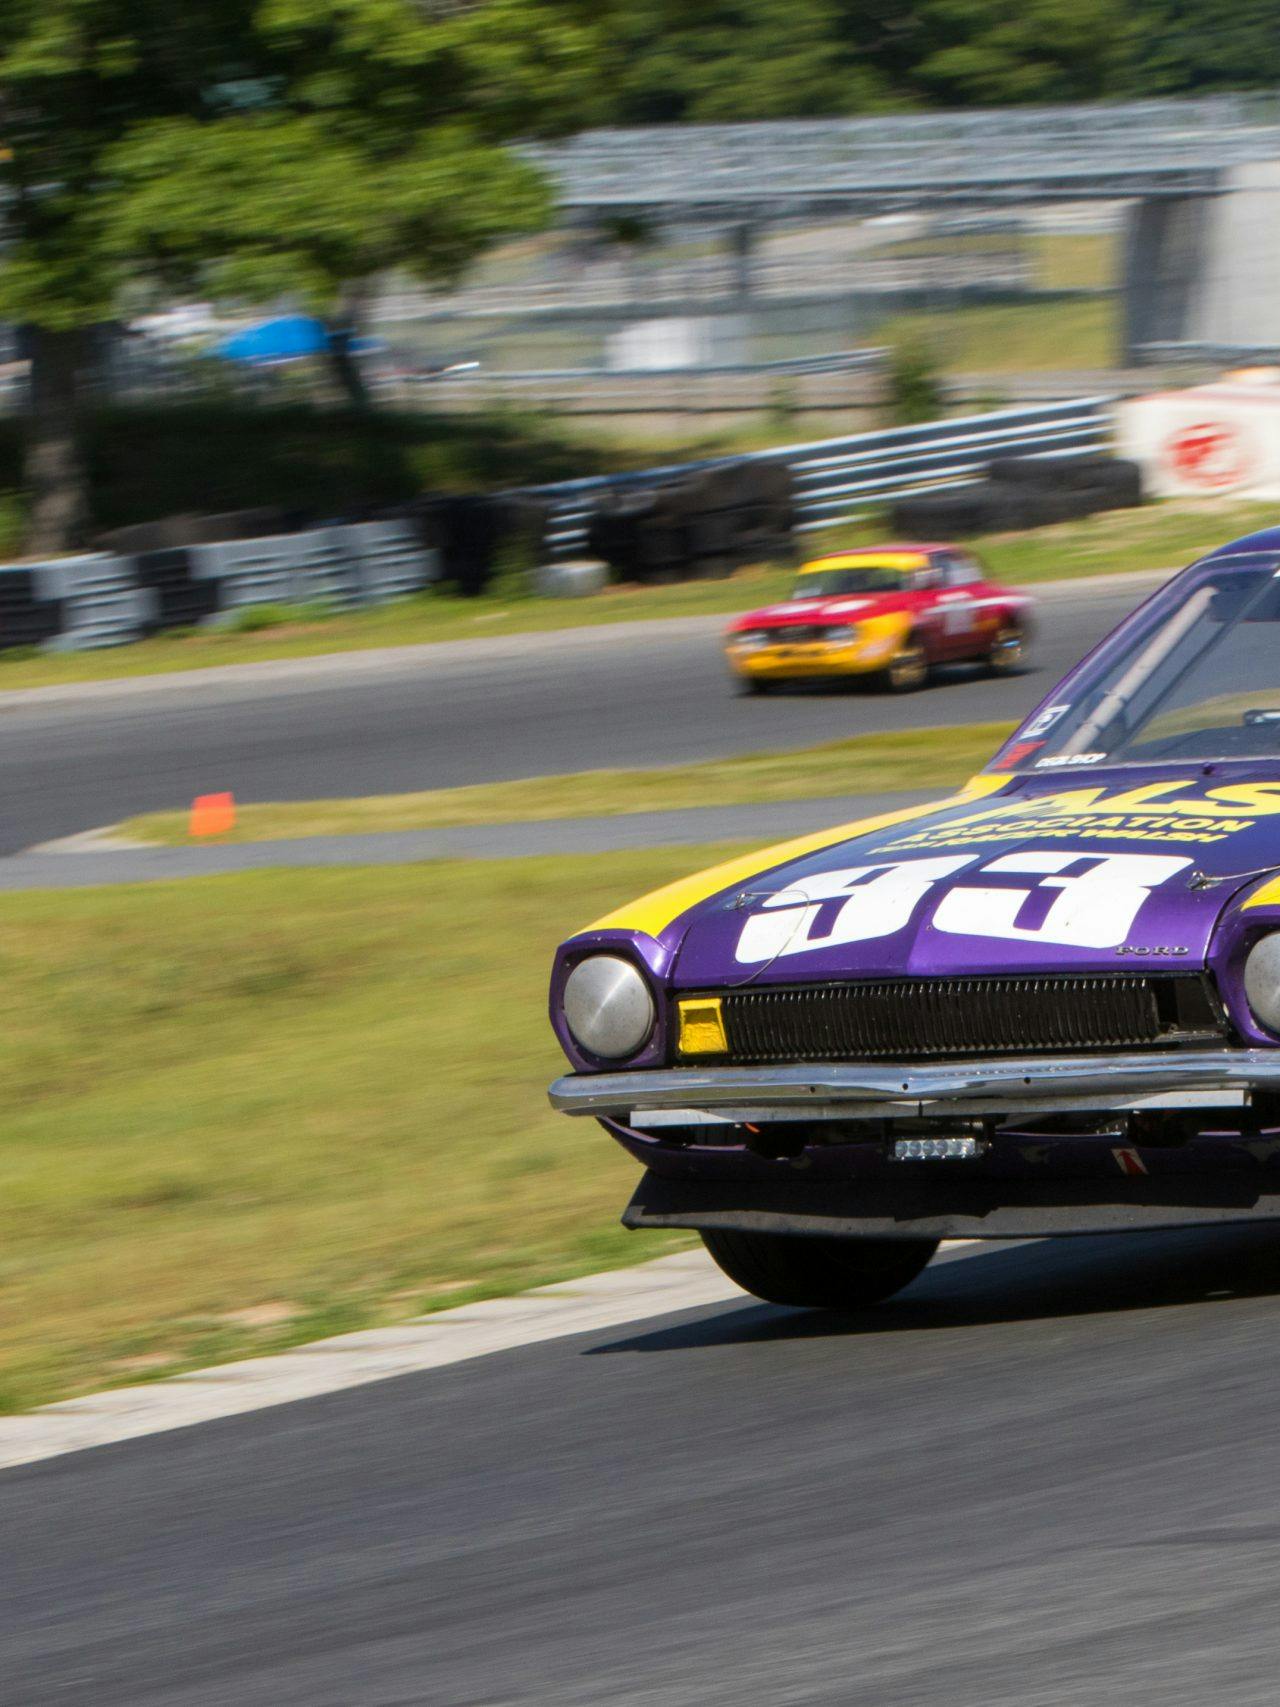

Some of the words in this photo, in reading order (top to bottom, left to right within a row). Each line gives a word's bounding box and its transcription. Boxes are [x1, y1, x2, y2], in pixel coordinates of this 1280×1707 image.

[886, 815, 1257, 846] ASSOCIATION
[1078, 829, 1229, 843] WALSH
[734, 851, 1195, 964] 93
[1115, 945, 1190, 956] FORD
